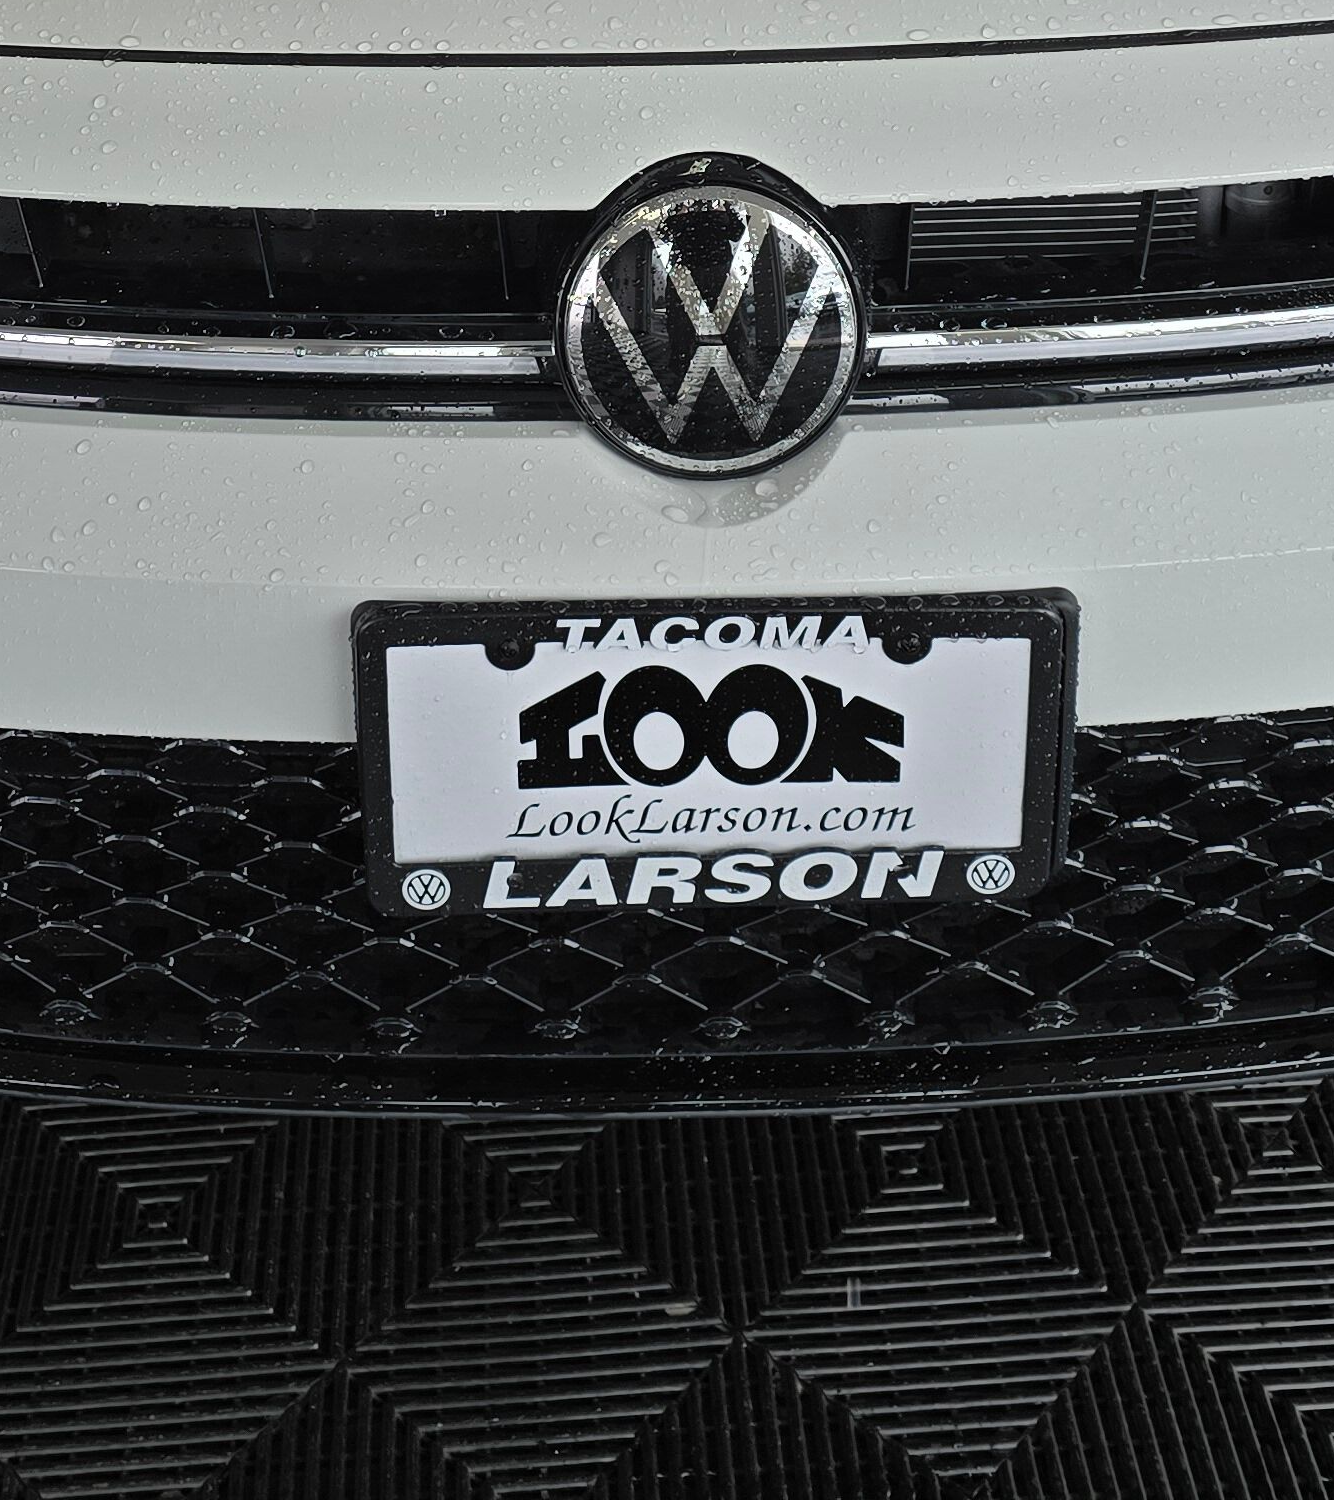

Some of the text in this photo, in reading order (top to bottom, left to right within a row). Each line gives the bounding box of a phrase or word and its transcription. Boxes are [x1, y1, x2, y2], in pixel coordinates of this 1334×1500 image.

[555, 615, 870, 652] TACOMA
[517, 663, 905, 789] LOOK
[506, 793, 918, 845] LookLarson.com
[482, 848, 945, 909] LARSON
